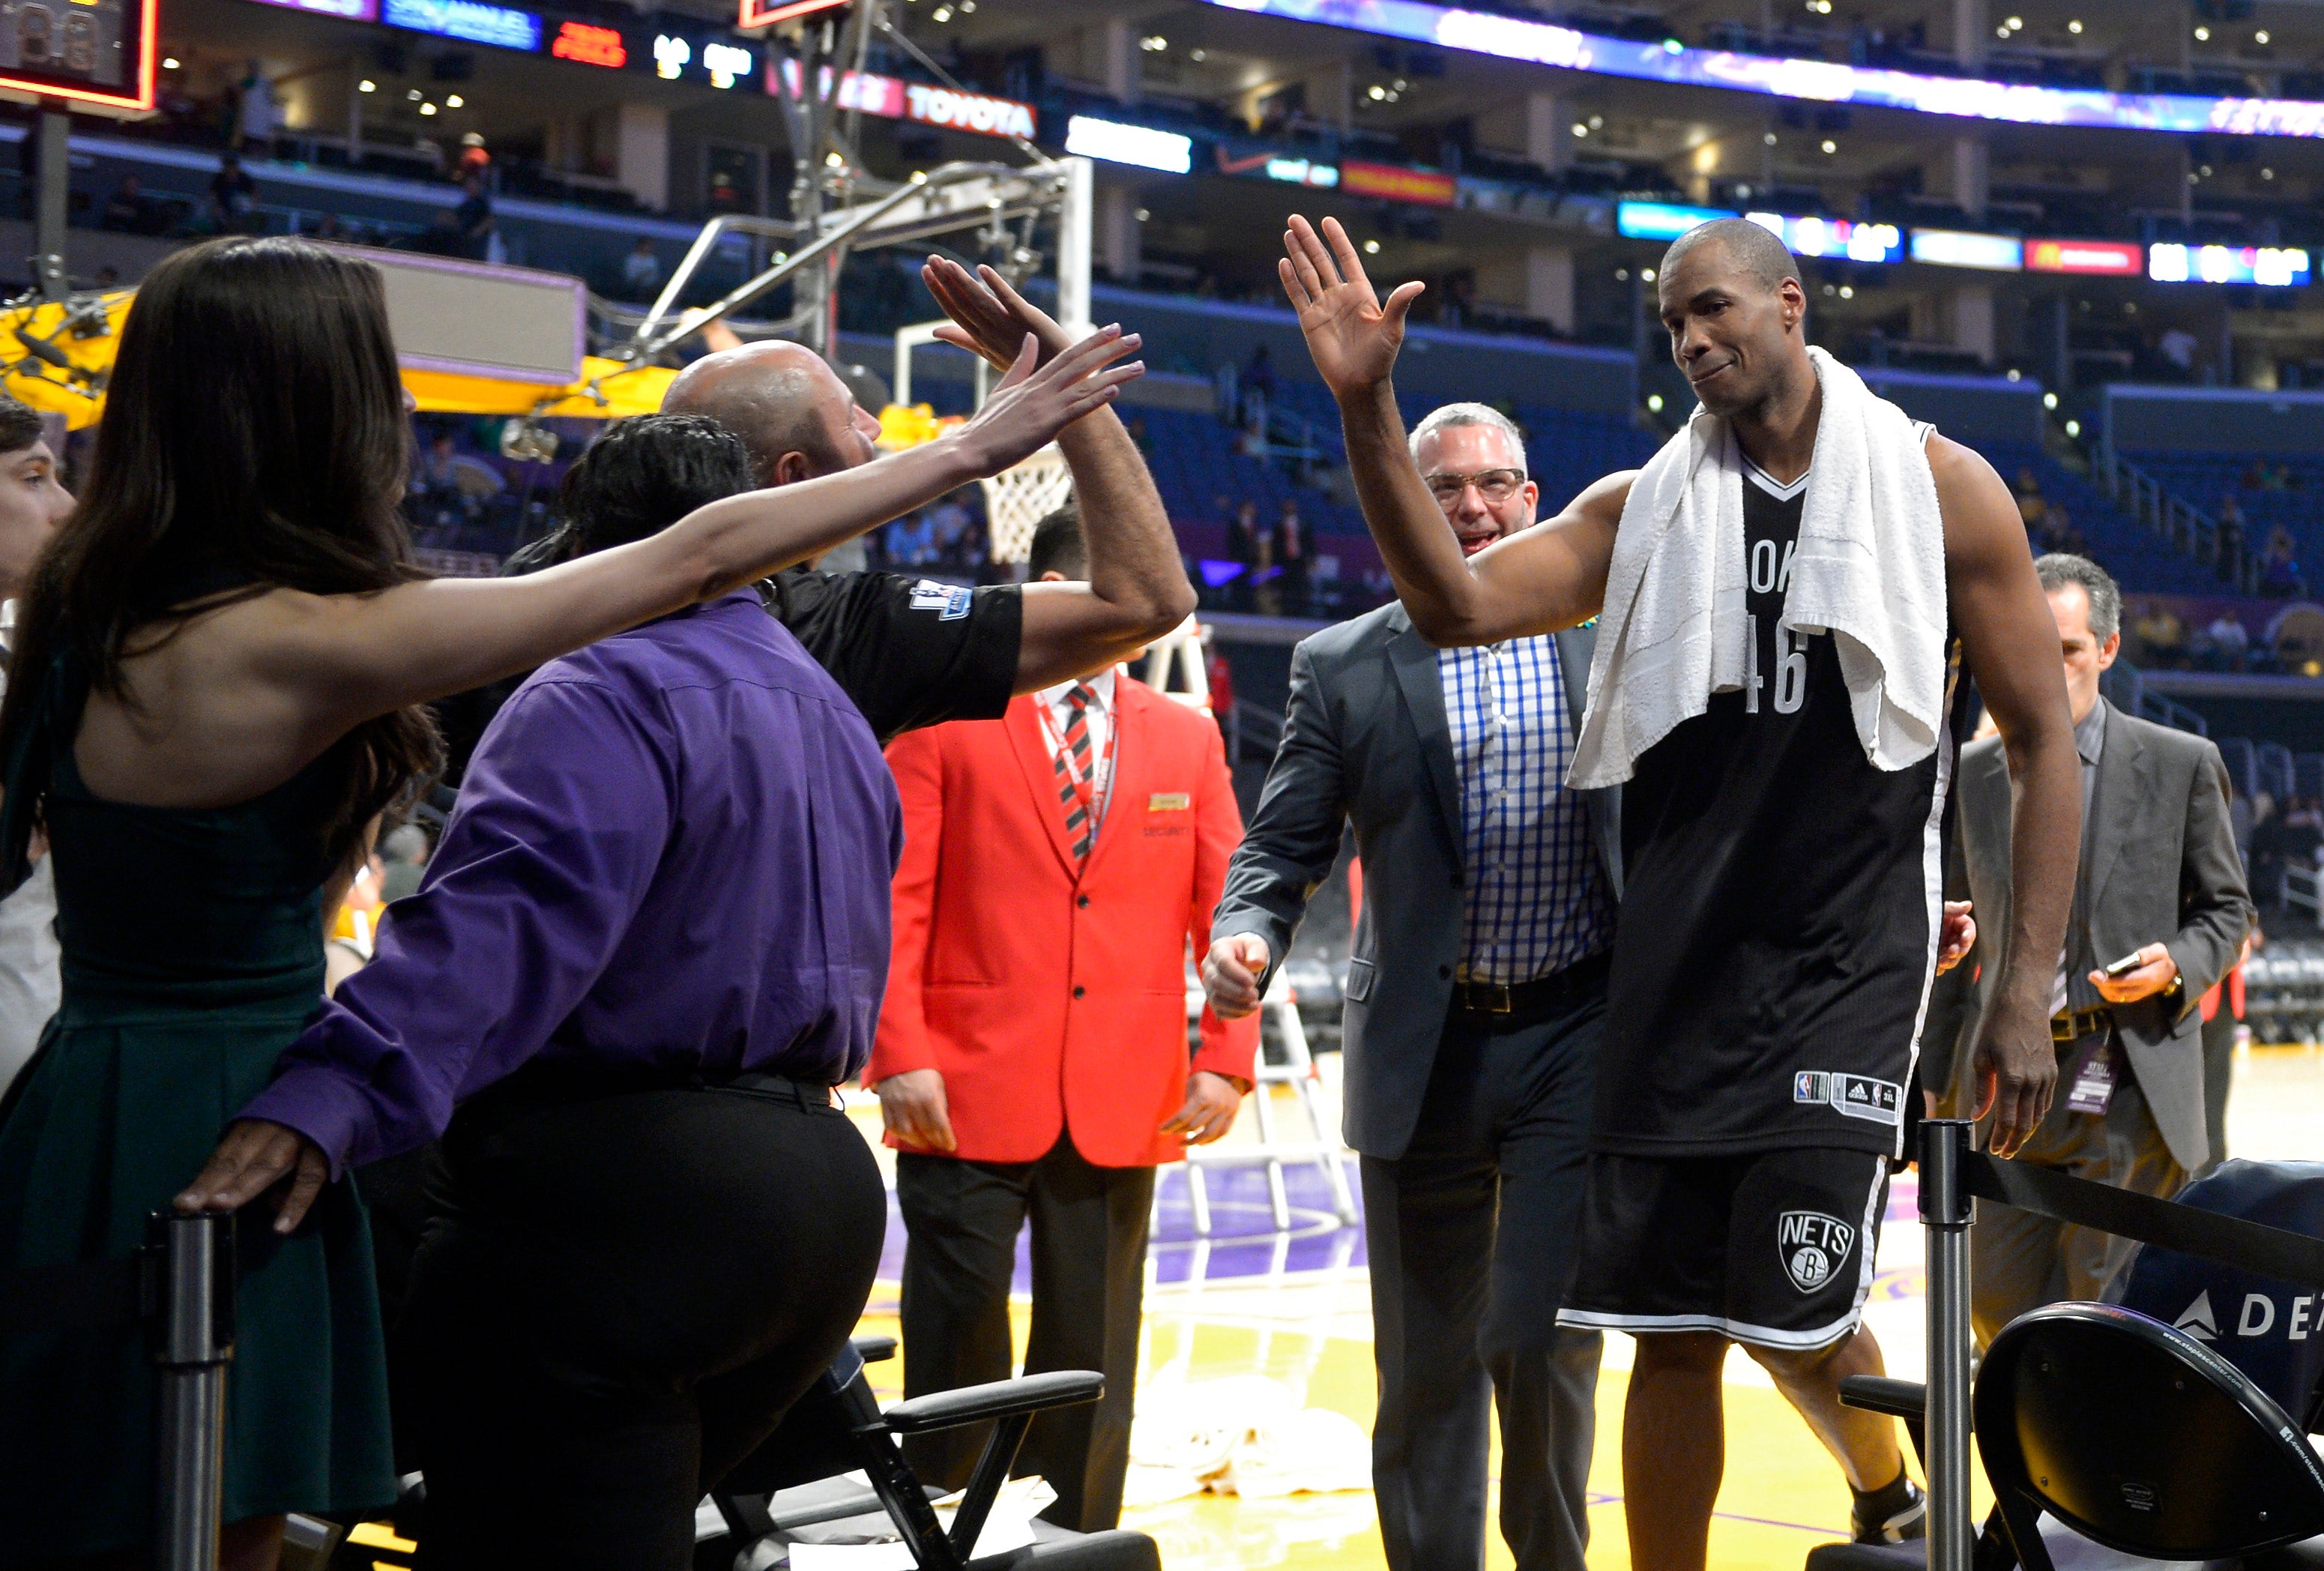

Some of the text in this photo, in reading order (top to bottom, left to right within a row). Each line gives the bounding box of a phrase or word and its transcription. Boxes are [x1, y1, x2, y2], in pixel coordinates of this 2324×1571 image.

[908, 85, 1035, 139] TOYOTA
[1782, 1215, 1849, 1256] NETS
[1802, 1253, 1817, 1280] B
[2163, 1330, 2243, 1390] www.staplescenter.com
